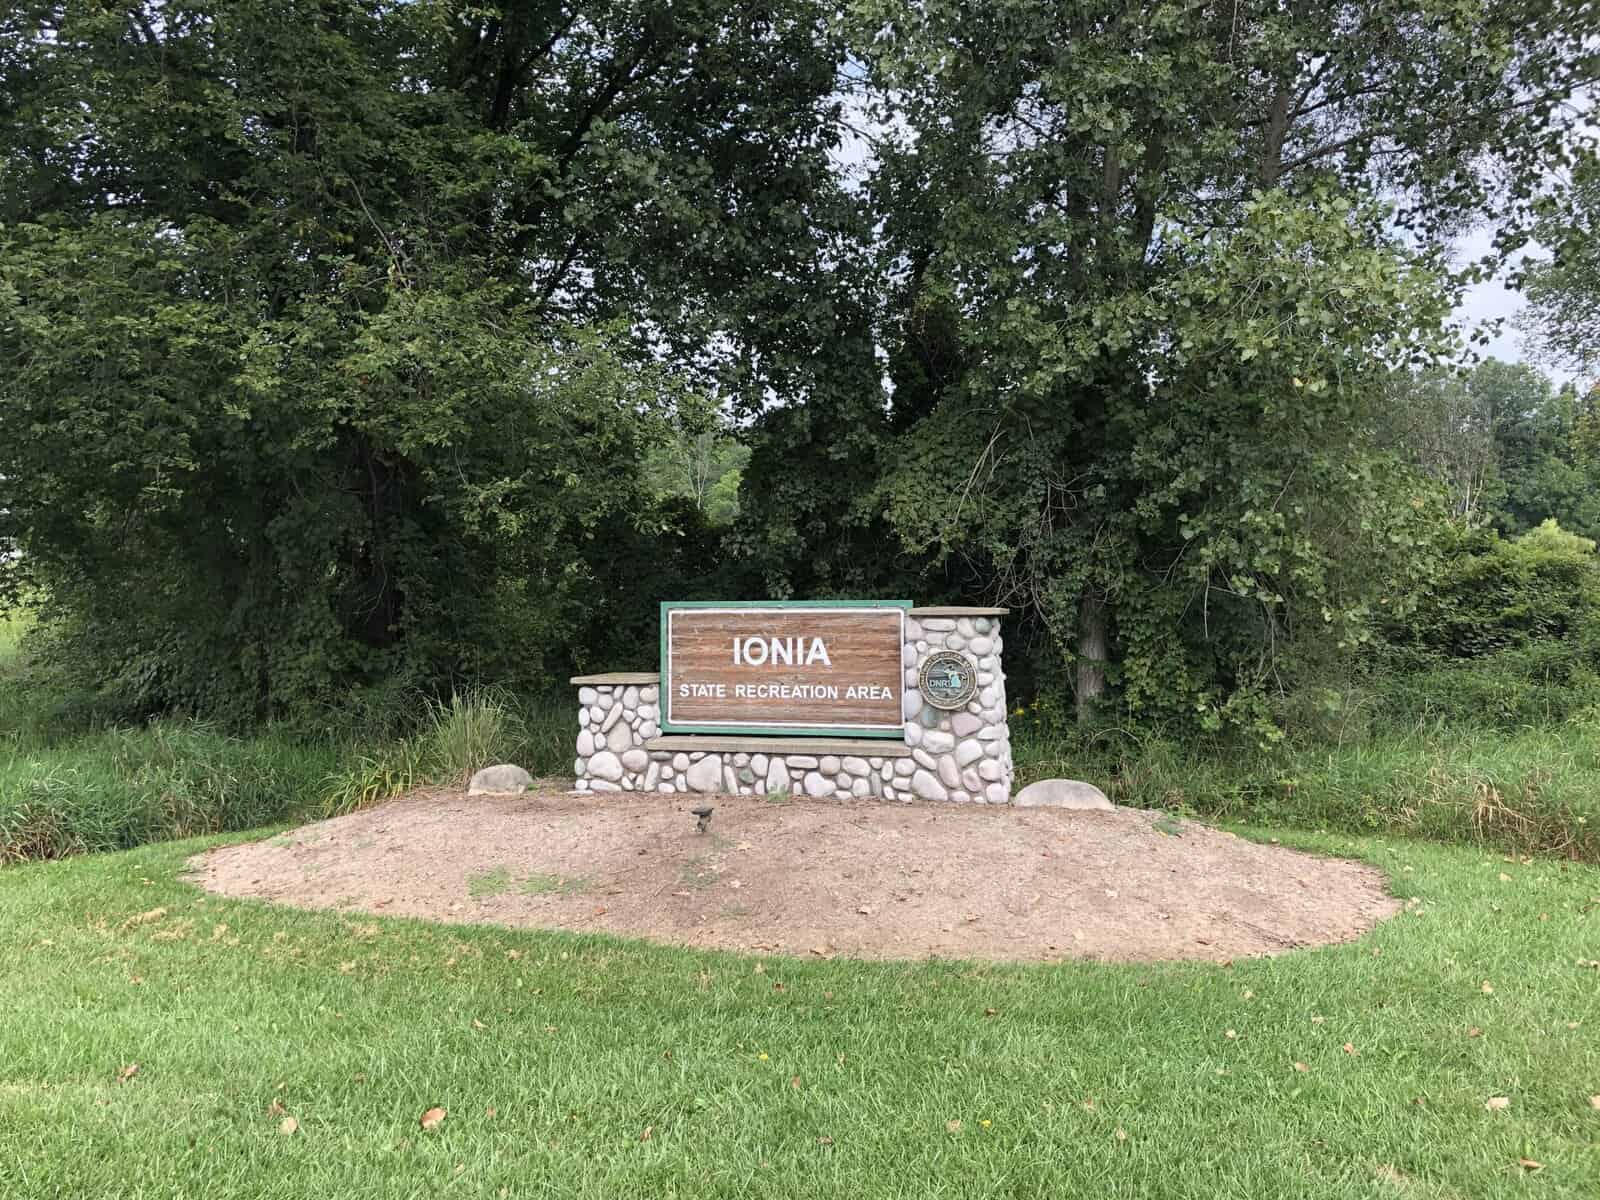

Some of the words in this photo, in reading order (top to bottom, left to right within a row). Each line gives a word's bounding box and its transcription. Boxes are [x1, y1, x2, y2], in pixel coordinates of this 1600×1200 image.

[733, 636, 832, 666] IONIA
[679, 683, 726, 698] STATE
[735, 684, 839, 699] RECREATION
[845, 685, 893, 700] AREA
